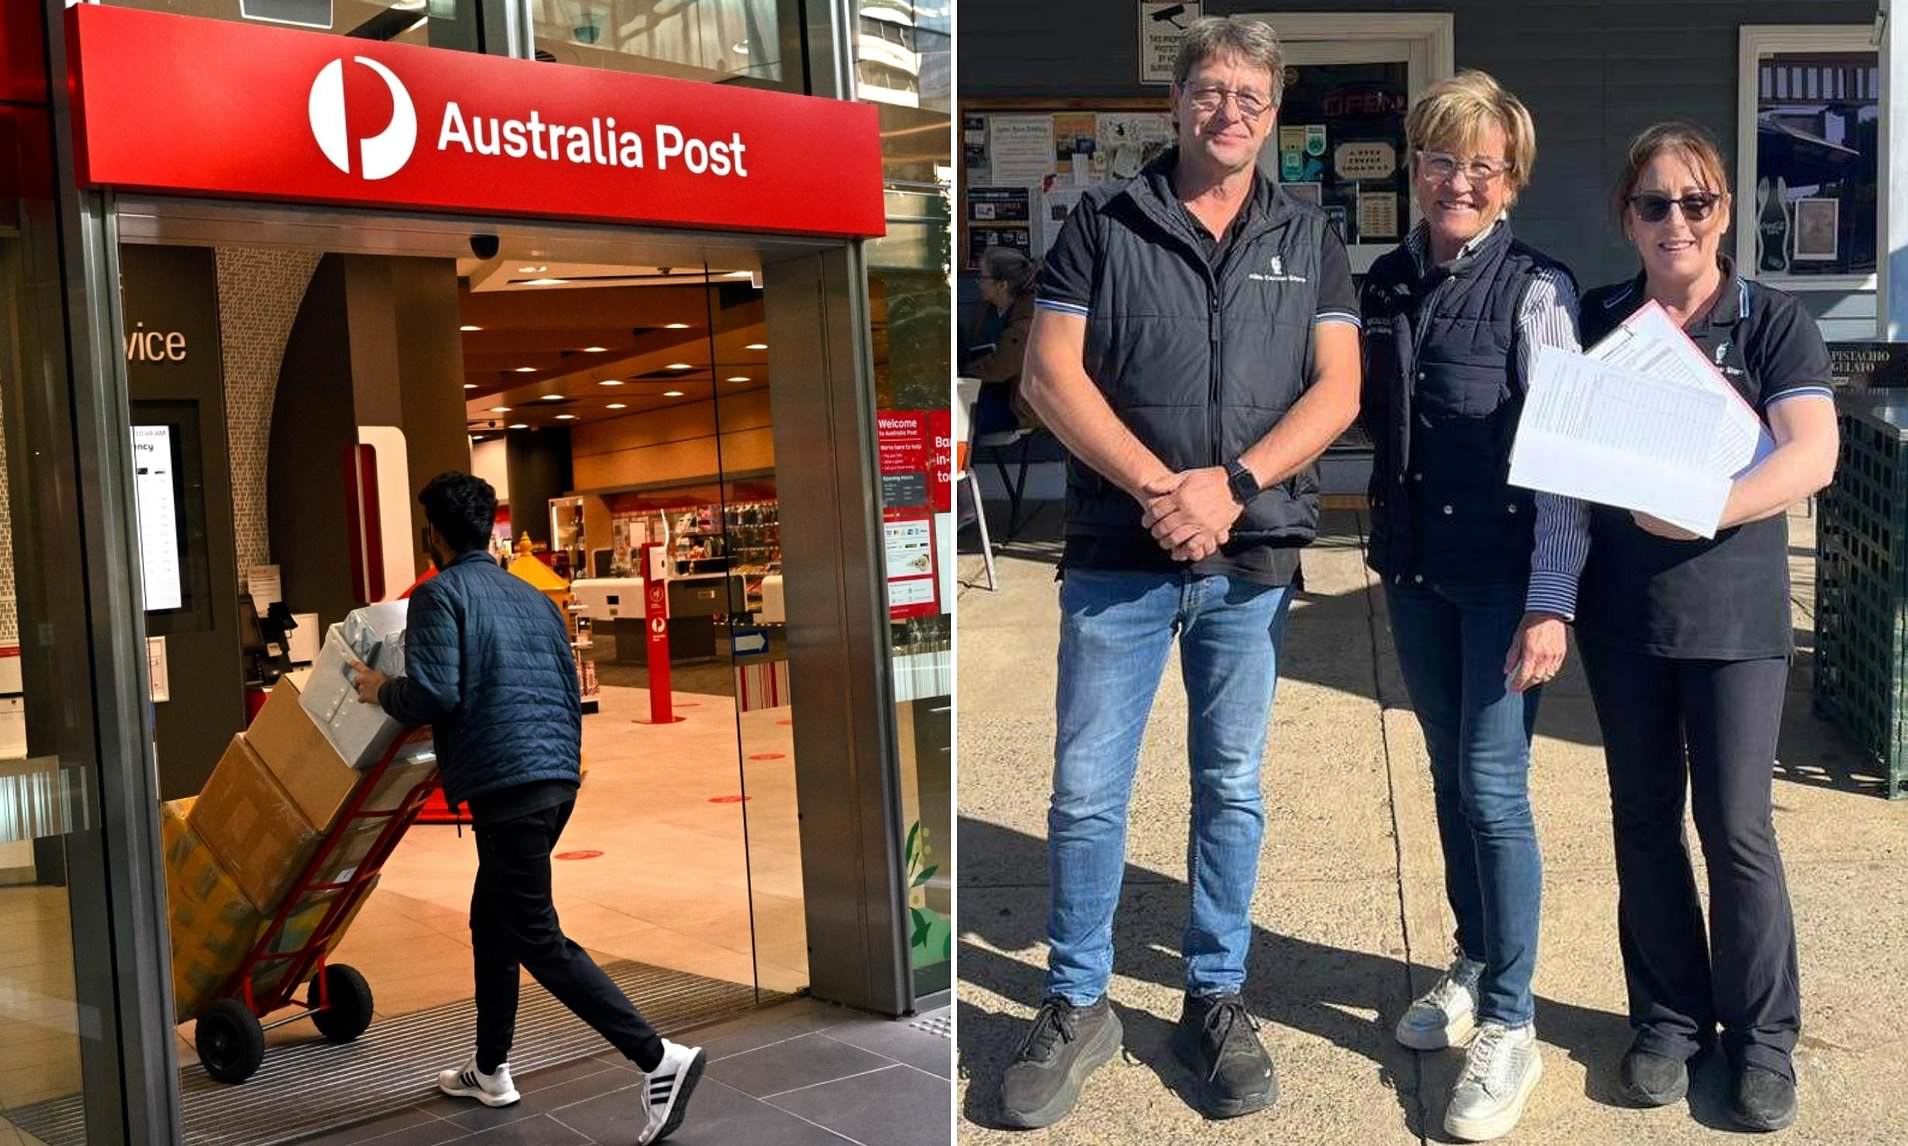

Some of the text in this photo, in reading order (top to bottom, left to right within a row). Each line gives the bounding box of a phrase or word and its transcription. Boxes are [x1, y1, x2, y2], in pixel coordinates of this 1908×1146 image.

[438, 102, 747, 176] Australia Post
[1831, 362, 1876, 372] GELATO
[878, 419, 918, 429] Welcome
[935, 436, 951, 448] Ba
[937, 470, 951, 483] to
